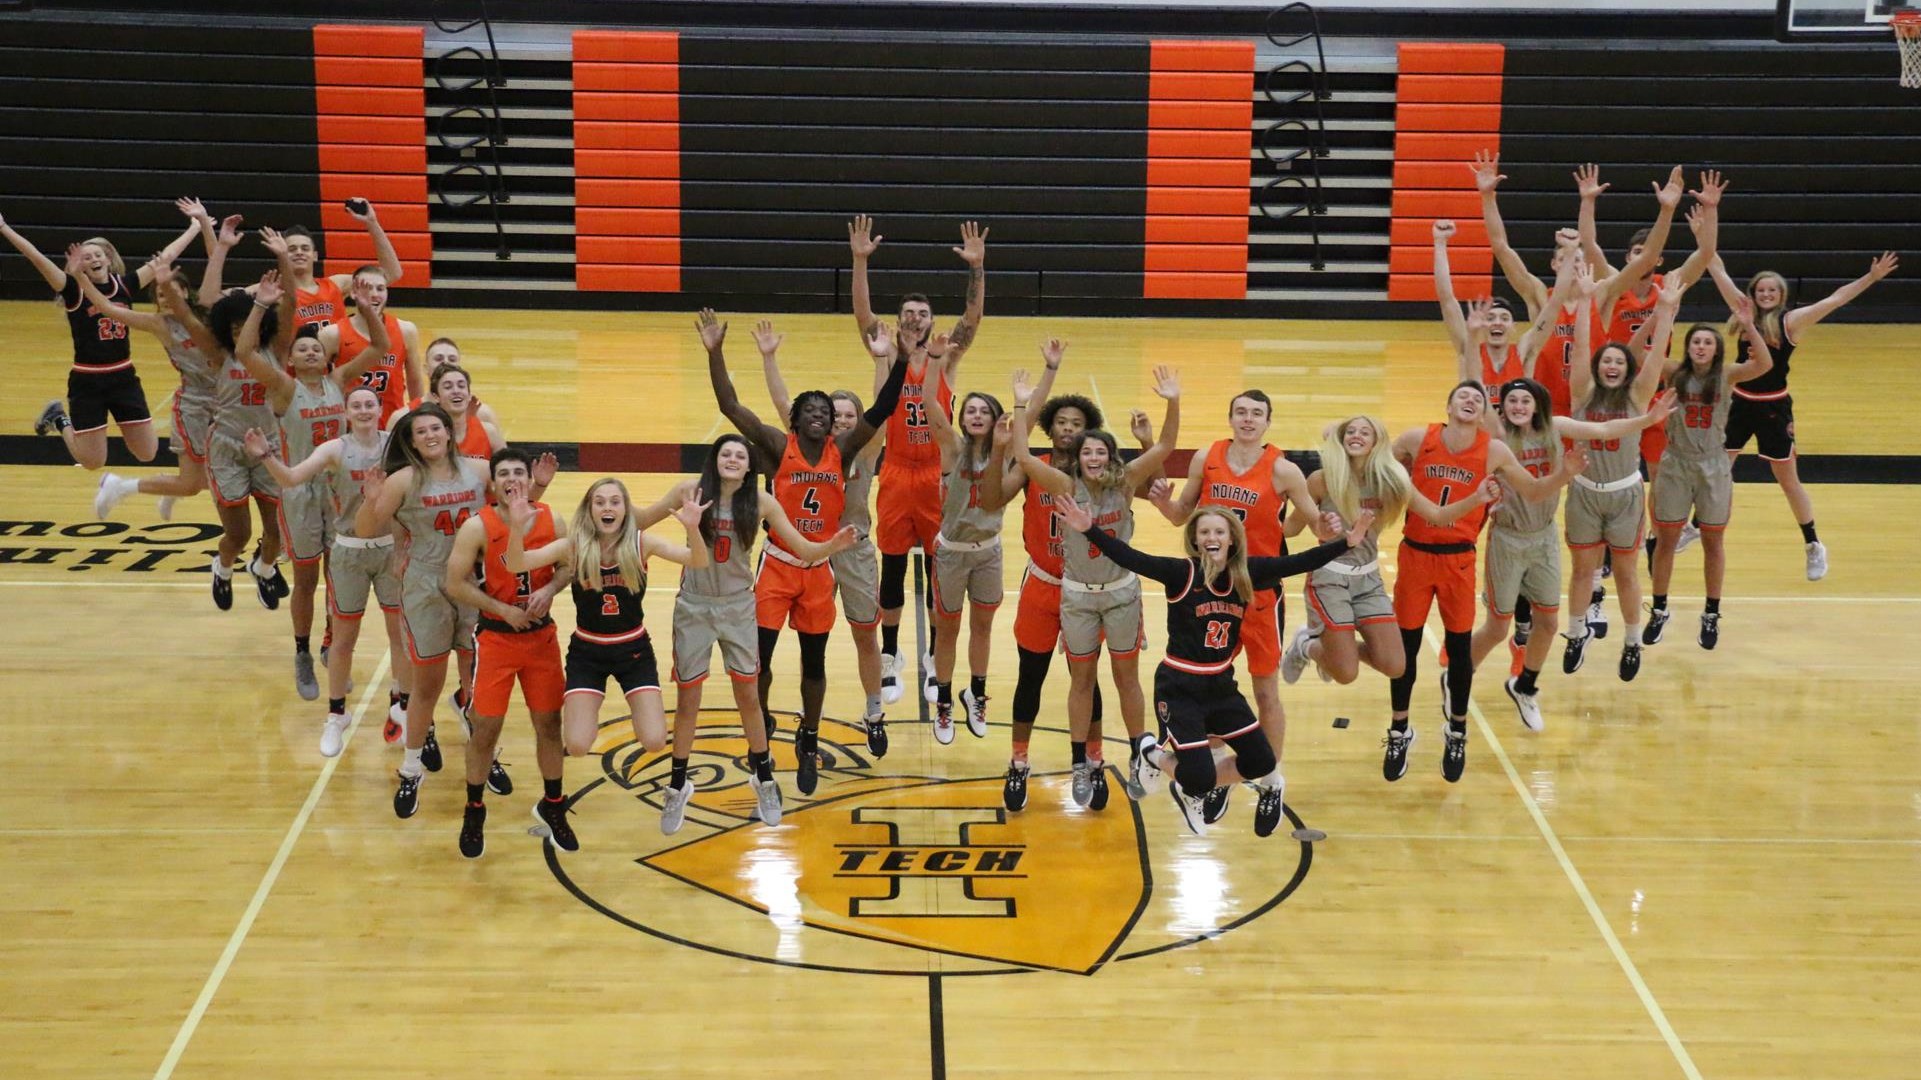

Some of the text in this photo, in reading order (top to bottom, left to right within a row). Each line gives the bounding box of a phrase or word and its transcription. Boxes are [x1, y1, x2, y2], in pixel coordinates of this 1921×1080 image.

[240, 382, 266, 406] 12
[1684, 404, 1713, 429] 25
[790, 470, 839, 487] INDIANA
[1425, 465, 1475, 485] INDIANA
[801, 487, 821, 516] 4
[1211, 483, 1259, 506] NDIANA
[795, 518, 825, 533] TECH
[713, 535, 731, 564] 0
[601, 593, 620, 616] 2
[1204, 620, 1231, 649] 21
[839, 851, 1024, 872] TECH
